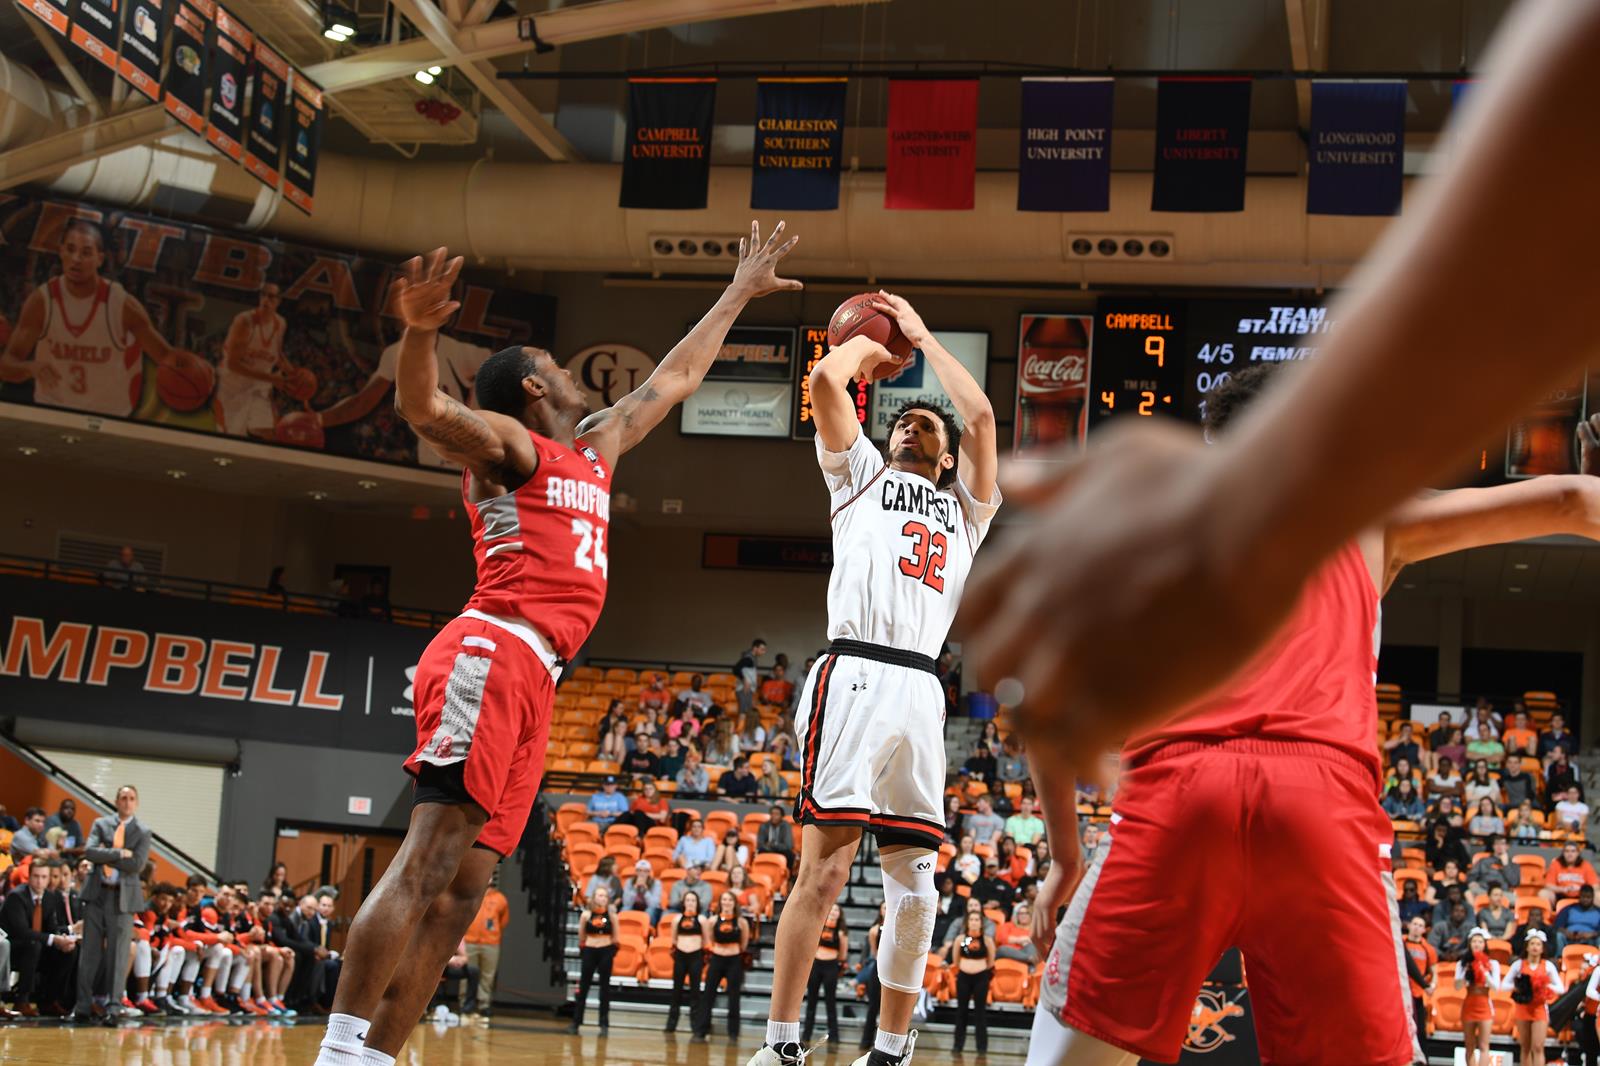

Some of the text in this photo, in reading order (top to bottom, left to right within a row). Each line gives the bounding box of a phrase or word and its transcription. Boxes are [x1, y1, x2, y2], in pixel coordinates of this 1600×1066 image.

[758, 118, 838, 132] CHARLESTON
[637, 127, 698, 142] CAMPBELL
[1027, 127, 1106, 141] HIGH POINT
[1175, 127, 1228, 142] LIBERTY
[1318, 131, 1396, 145] LONGWOOD
[764, 136, 830, 150] SOUTHERN
[632, 144, 704, 158] UNIVERSITY
[1027, 146, 1104, 160] UNIVERSITY
[1162, 147, 1240, 160] UNIVERSITY
[1316, 151, 1397, 165] UNIVERSITY
[760, 154, 833, 169] UNIVERSITY
[1105, 312, 1174, 331] CAMPBELL
[1269, 306, 1328, 325] TEAM
[47, 340, 112, 364] AMELS
[813, 344, 823, 359] 3
[1144, 335, 1165, 367] 9
[1197, 343, 1235, 364] 4/5
[1023, 354, 1086, 382] Coca-Cola
[69, 363, 88, 395] 3
[1101, 391, 1115, 409] 4
[1138, 391, 1155, 416] 2
[697, 407, 774, 420] HARNETT HEALTH
[571, 517, 608, 580] 24
[898, 520, 948, 594] 32
[0, 615, 344, 711] MPBELL
